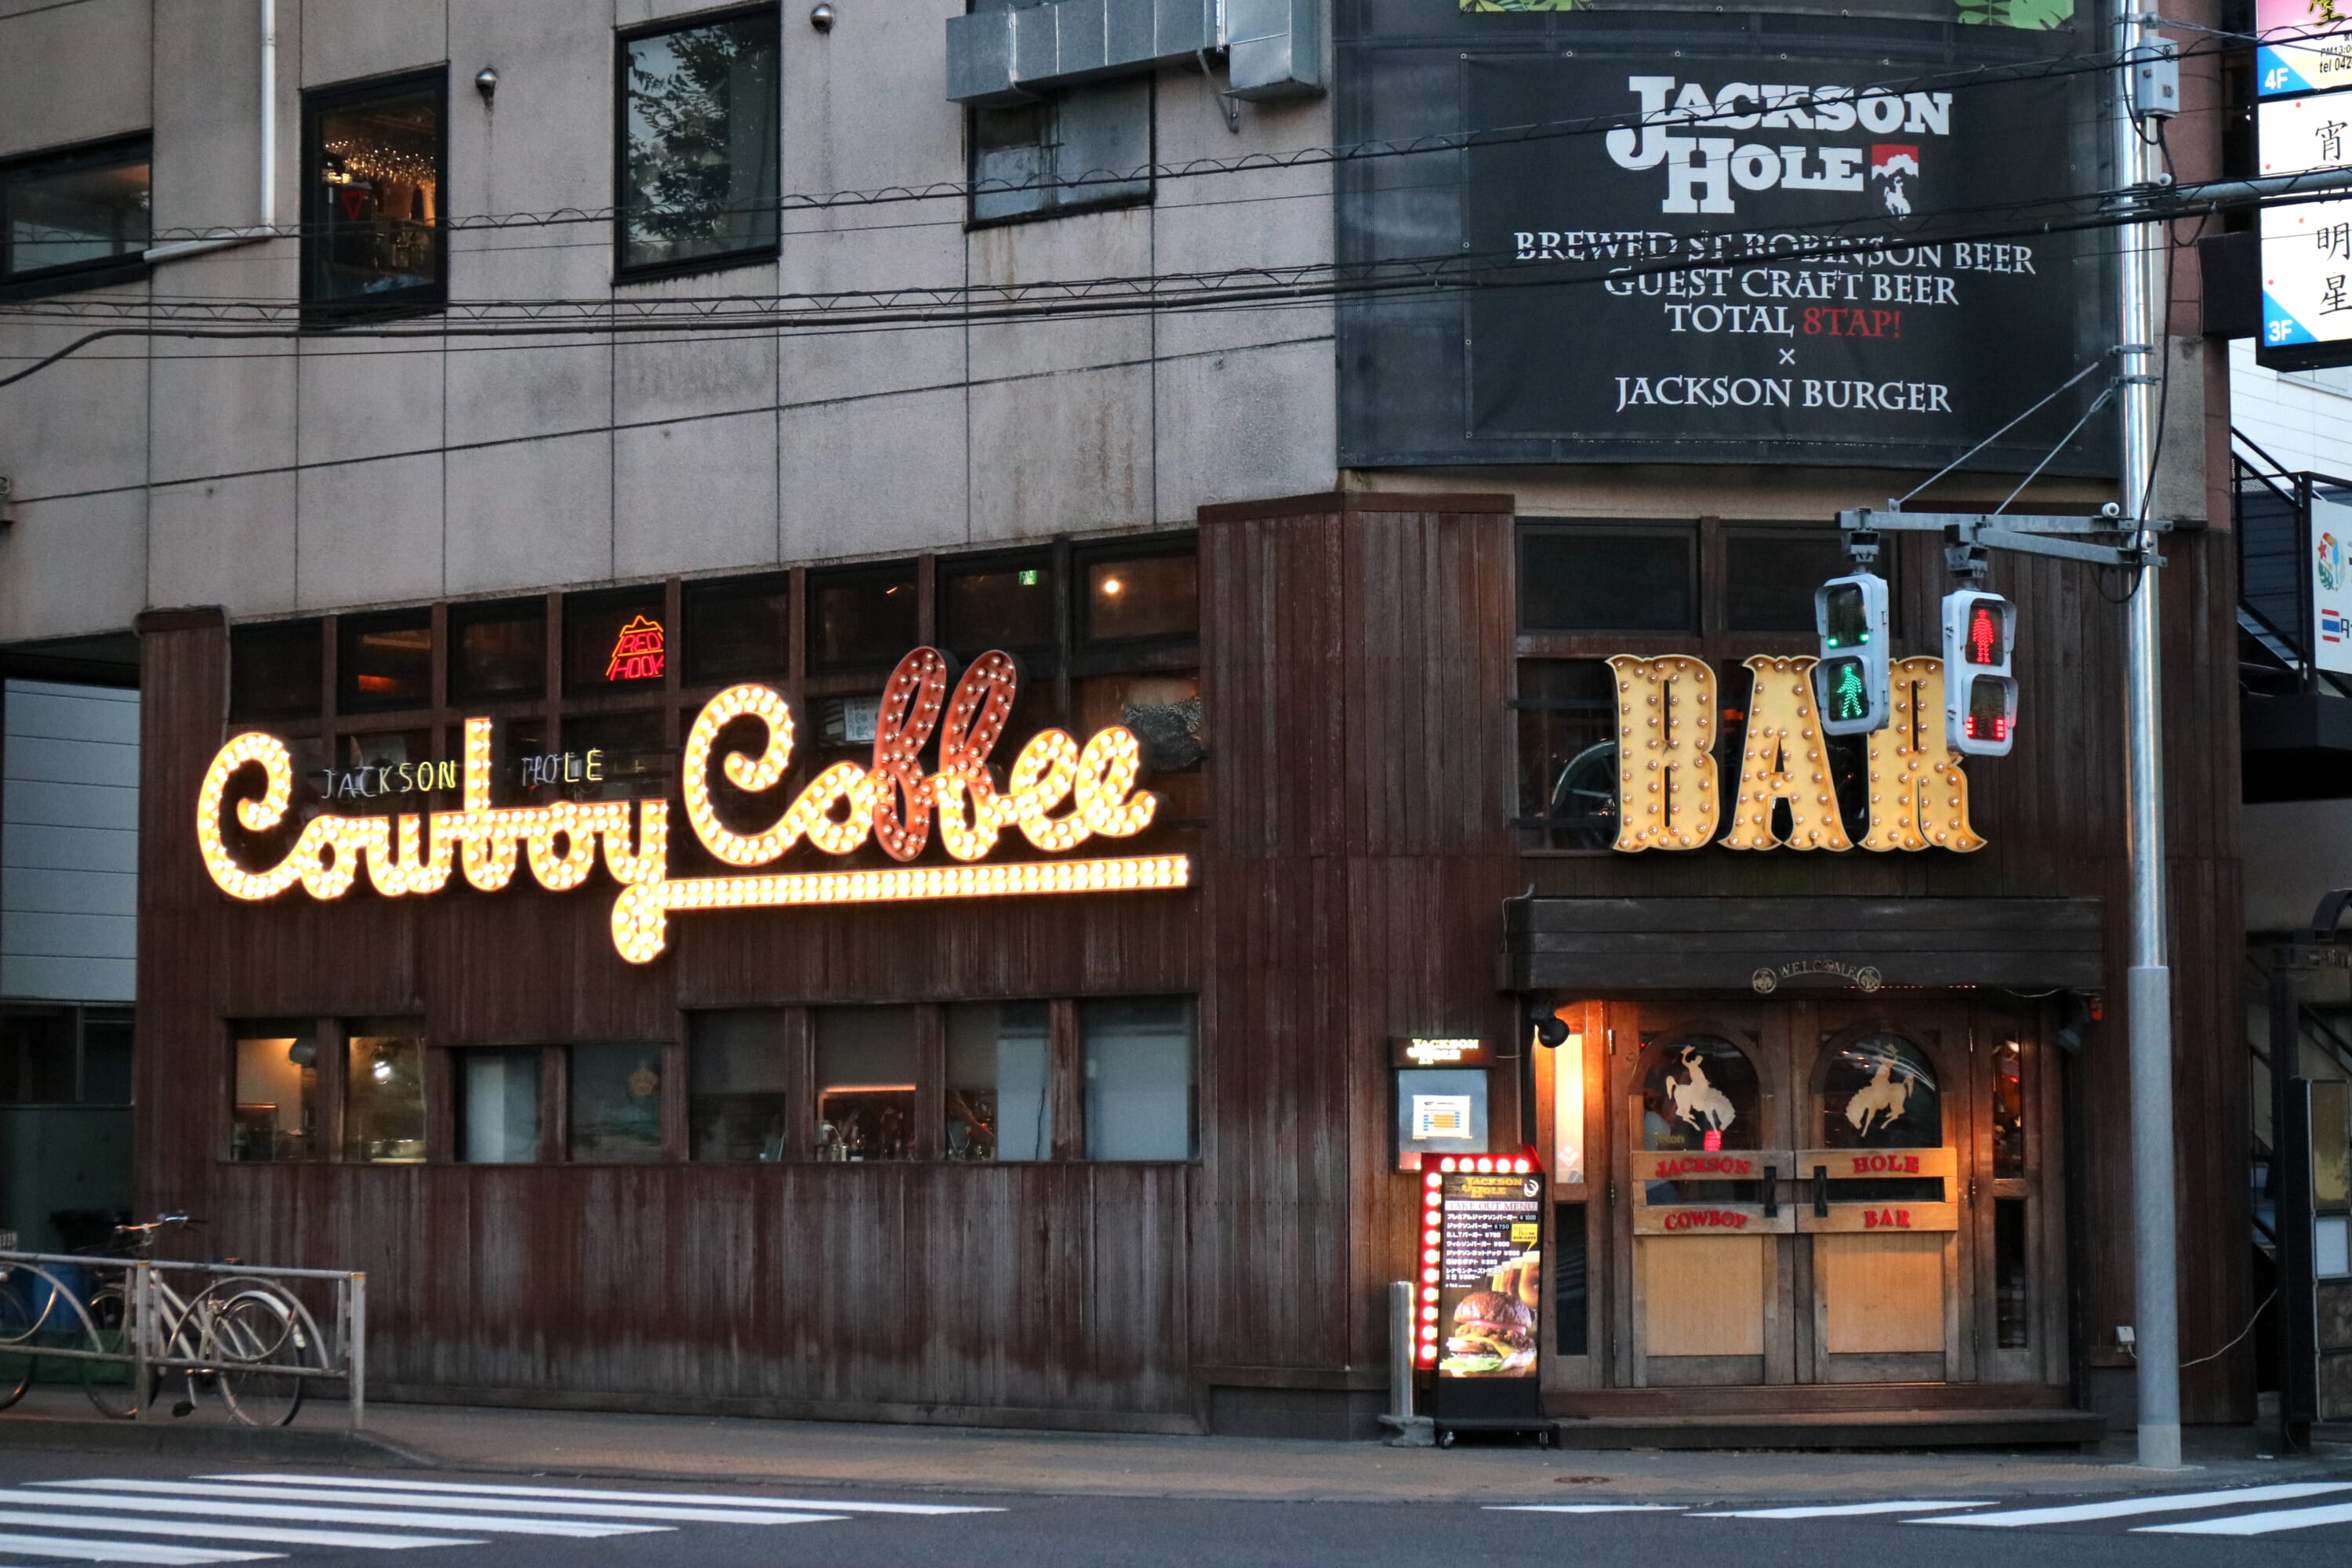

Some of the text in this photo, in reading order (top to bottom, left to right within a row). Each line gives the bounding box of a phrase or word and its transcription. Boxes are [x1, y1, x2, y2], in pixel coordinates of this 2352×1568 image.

[2319, 59, 2332, 73] tel
[2264, 67, 2288, 90] 4F
[1606, 76, 1952, 170] JACKSON
[1661, 136, 1864, 214] HOLE
[1513, 230, 1675, 261] BREWED
[1953, 242, 2036, 274] BEER
[1605, 266, 1958, 305] GUEST CRAFT BEER
[1664, 303, 1901, 338] TOTAL 8TAP!
[2269, 321, 2292, 342] 3F
[1615, 377, 1952, 414] JACKSON BURGER
[619, 632, 662, 654] RED
[1604, 654, 1987, 852] BAR
[321, 748, 604, 799] JACKSON HOLE
[197, 646, 1156, 964] Cowboy Coffee
[1778, 960, 1857, 978] WELCOME
[1655, 1154, 1919, 1178] JACKSON HOLE
[1461, 1177, 1523, 1192] JACKSON
[1471, 1186, 1507, 1198] HOLE
[1450, 1201, 1475, 1210] TAKE
[1479, 1202, 1502, 1210] OUT
[1664, 1209, 1911, 1230] COWBOY BAR
